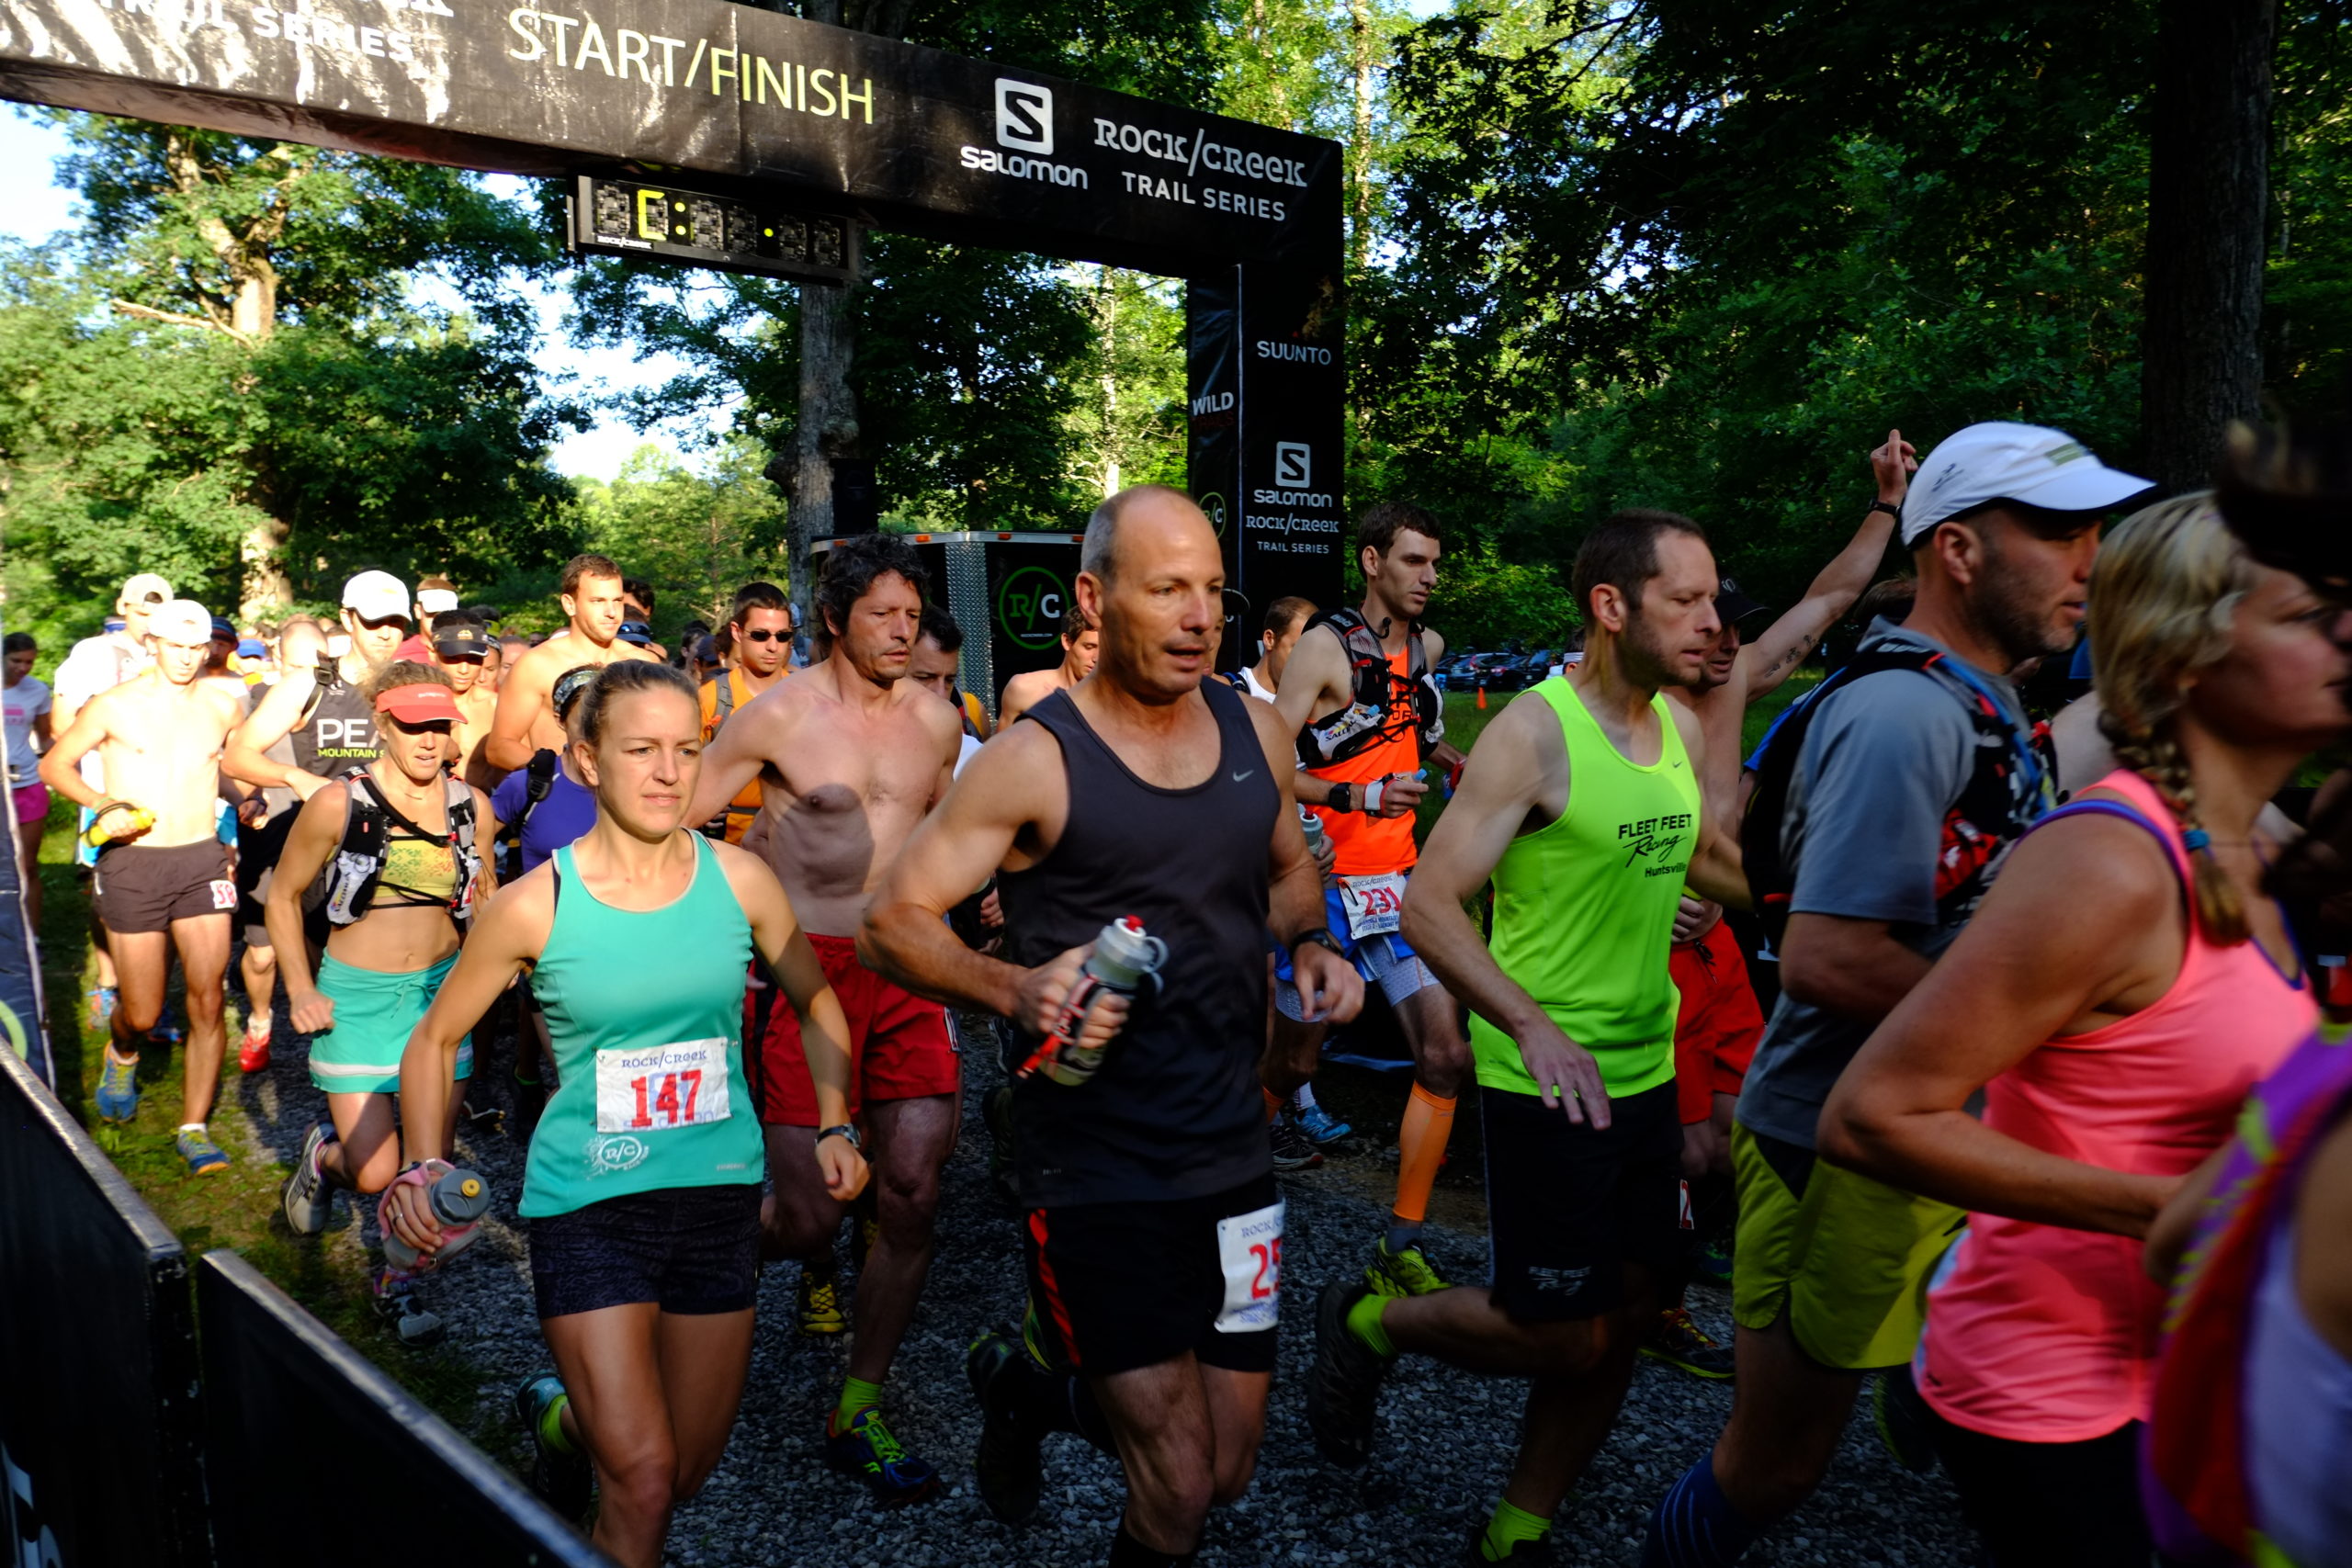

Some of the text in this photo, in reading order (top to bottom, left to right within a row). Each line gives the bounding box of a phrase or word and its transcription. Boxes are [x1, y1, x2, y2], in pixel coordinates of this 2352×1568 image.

[253, 6, 413, 62] SERIES
[508, 7, 874, 125] START/FINISH
[1122, 171, 1286, 221] TRAIL SERIES
[1256, 340, 1331, 366] SUUNTO
[1192, 390, 1235, 417] WILD
[1257, 540, 1329, 554] TRAIL SERIES
[1009, 583, 1060, 631] R/C
[317, 748, 377, 759] MOUNTAIN
[1618, 813, 1692, 840] FLEET FEET
[1358, 886, 1401, 917] 231
[631, 1068, 702, 1128] 147
